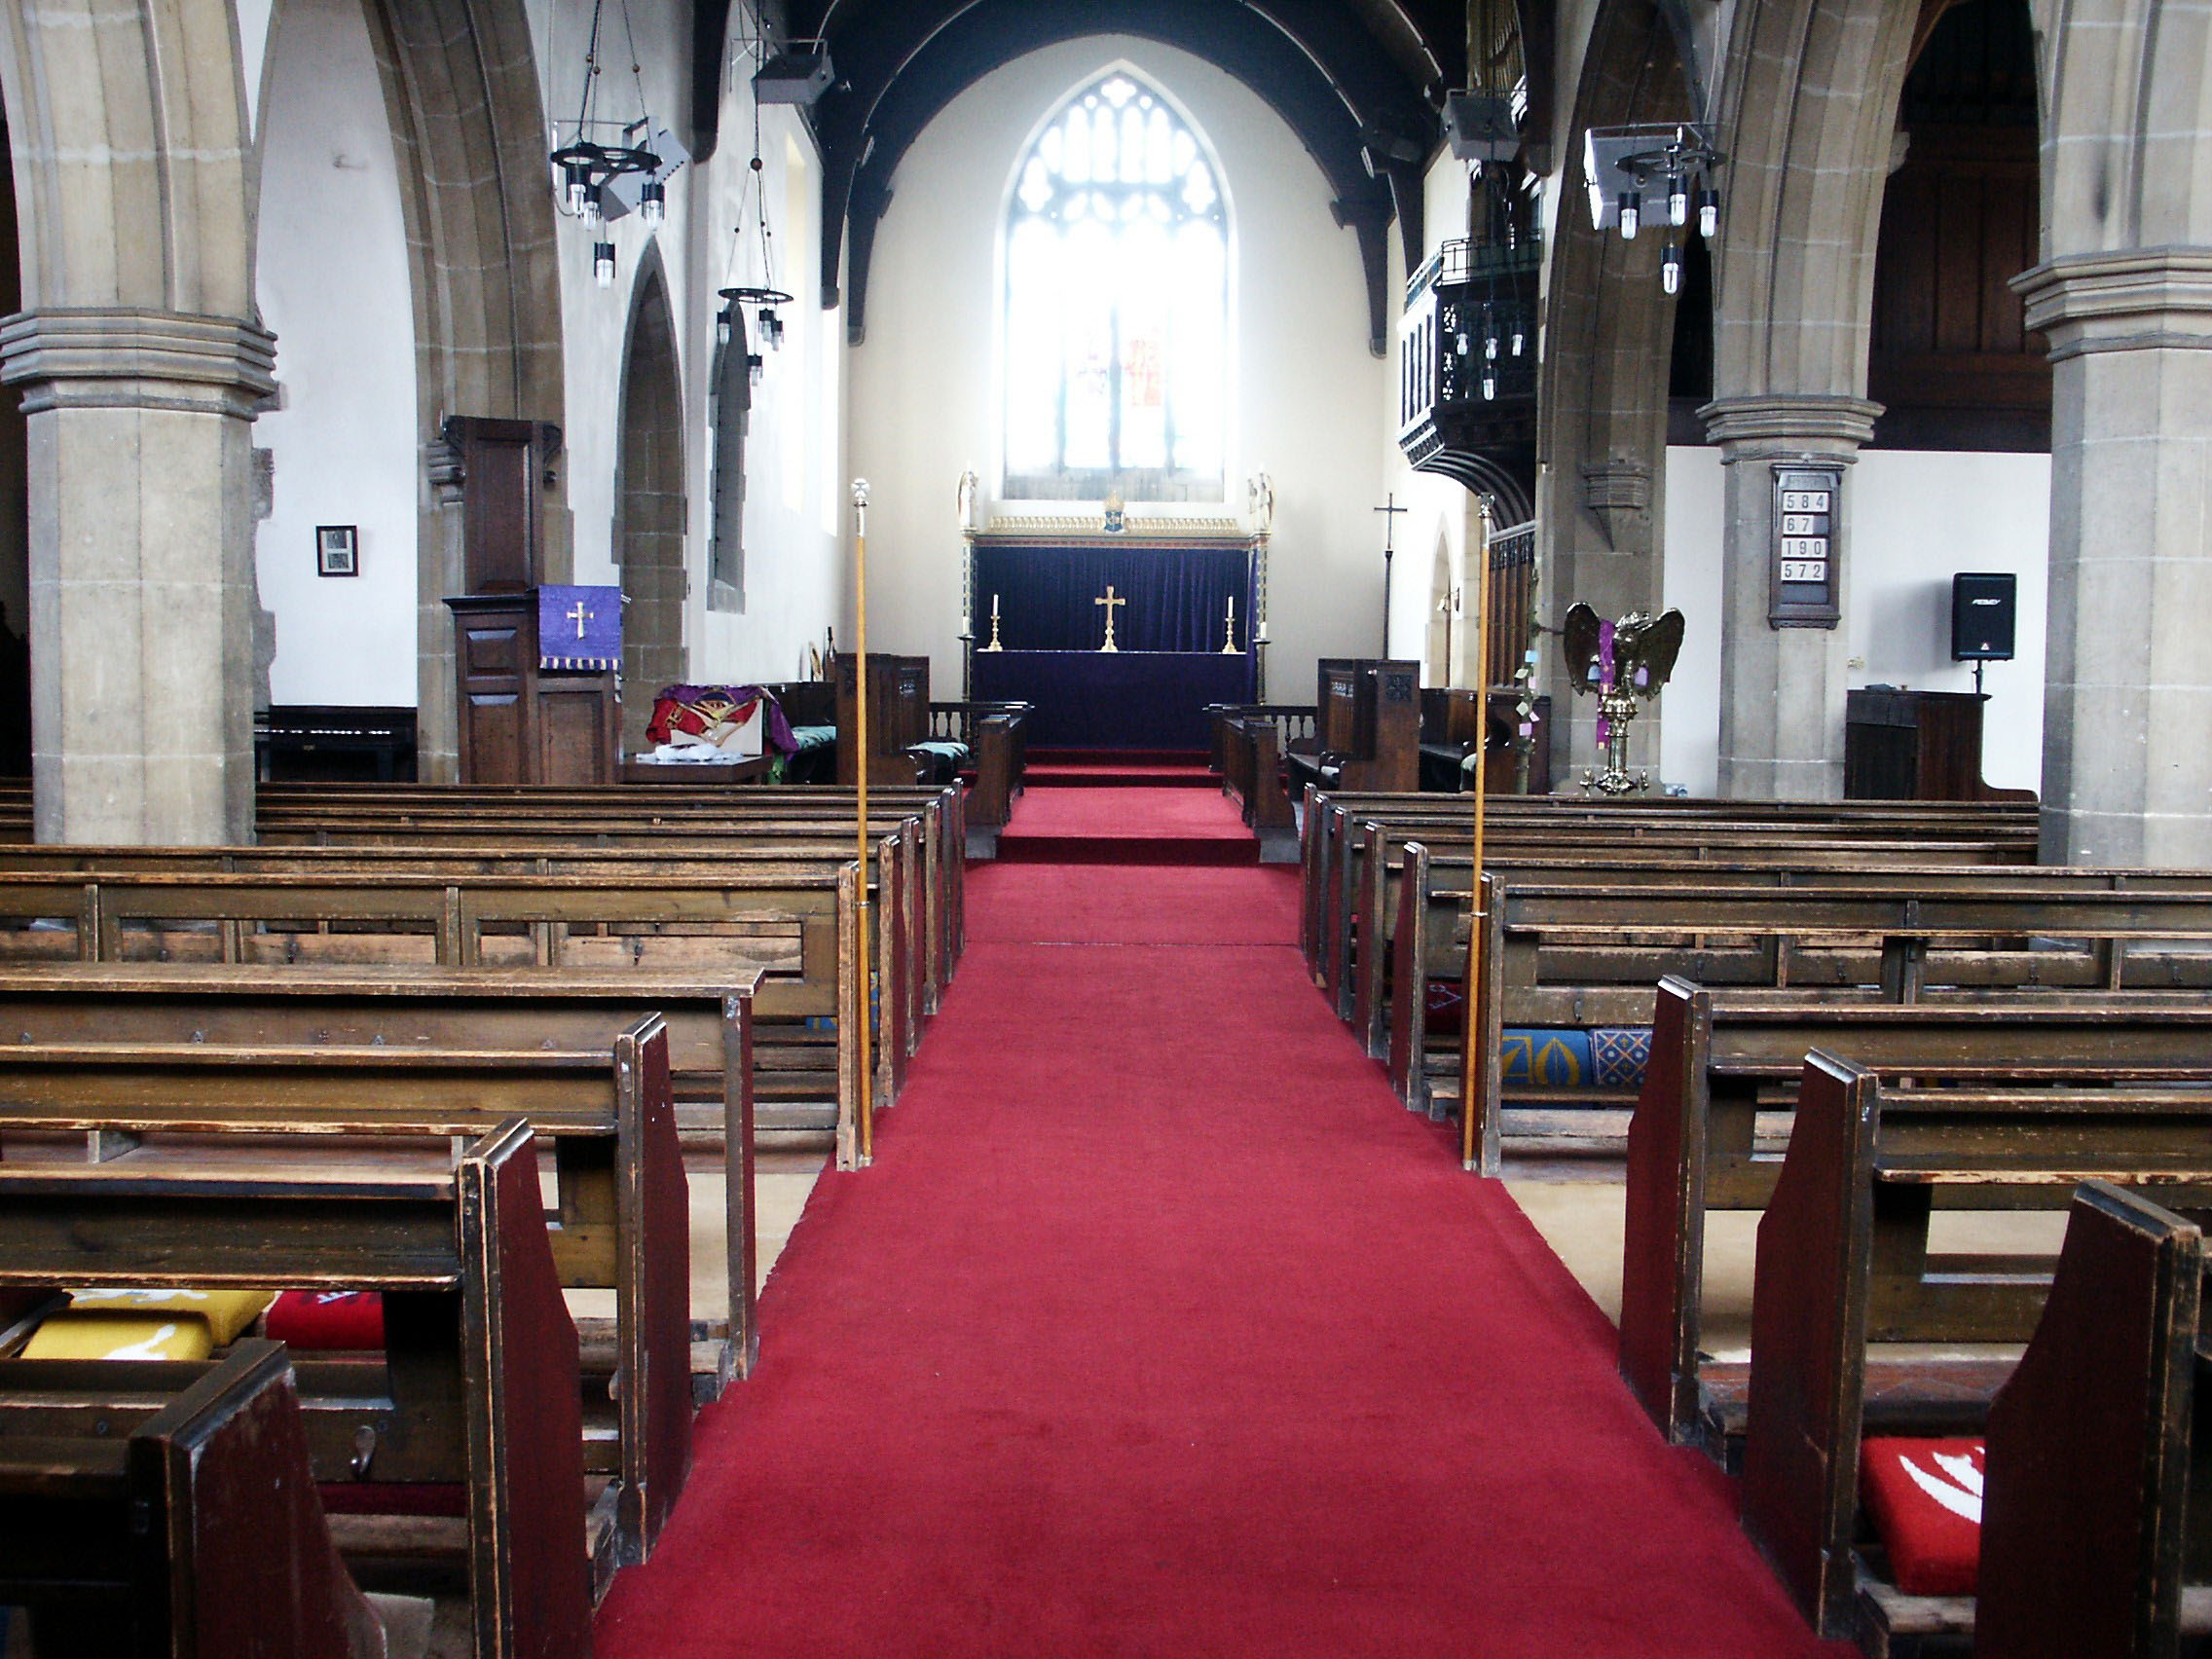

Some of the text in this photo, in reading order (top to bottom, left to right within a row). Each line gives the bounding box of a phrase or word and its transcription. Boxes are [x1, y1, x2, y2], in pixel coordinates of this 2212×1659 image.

[1787, 495, 1824, 509] 584
[1787, 517, 1810, 532] 67
[1787, 540, 1822, 555] 190
[1785, 564, 1821, 578] 572
